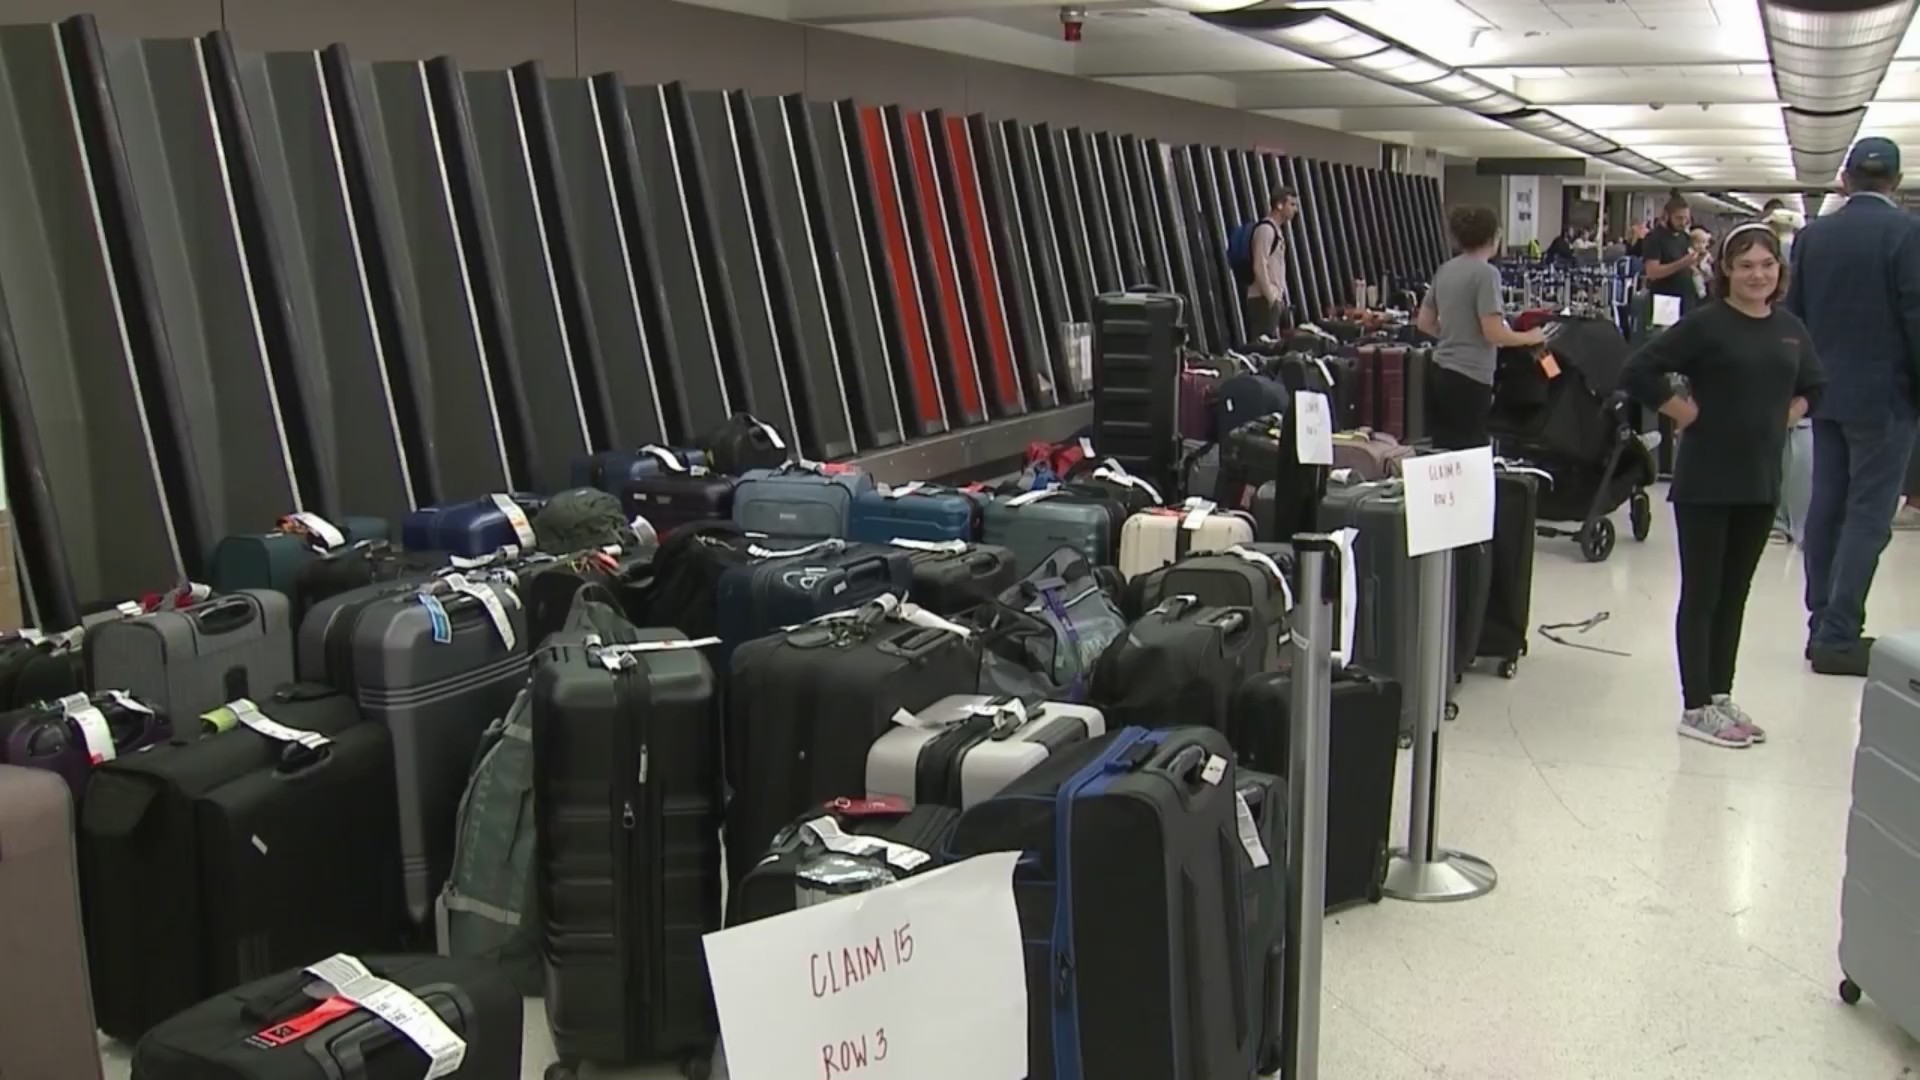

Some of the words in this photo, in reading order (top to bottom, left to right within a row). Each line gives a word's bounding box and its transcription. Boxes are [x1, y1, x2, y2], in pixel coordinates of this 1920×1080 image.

[810, 936, 887, 998] CLAIM
[893, 923, 914, 965] 15
[822, 1034, 869, 1080] ROW
[873, 1027, 888, 1062] 3
